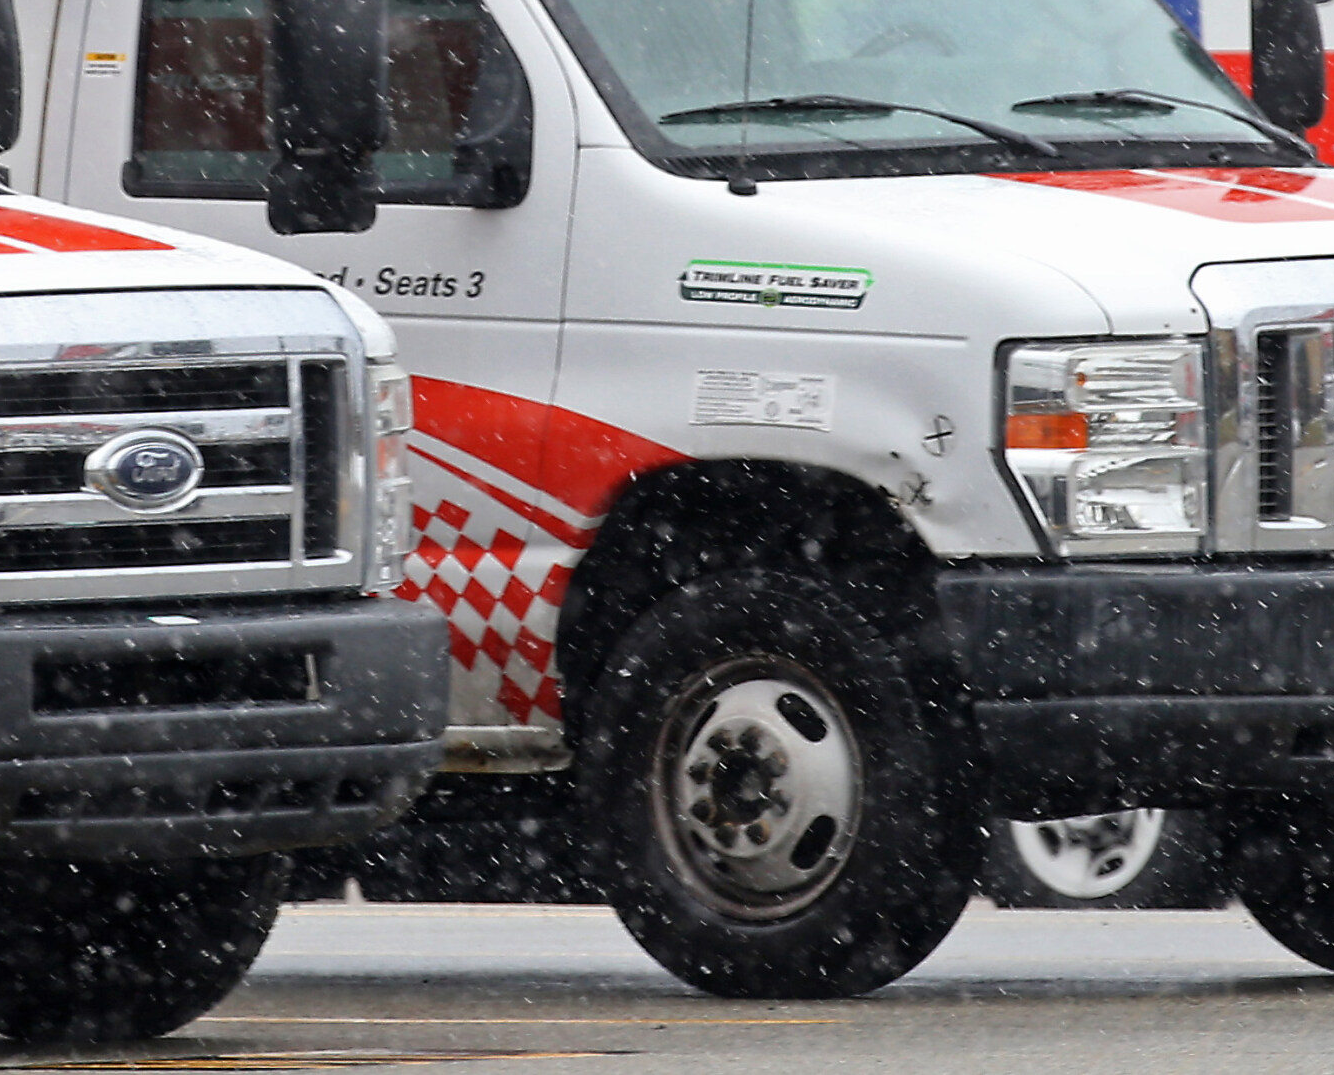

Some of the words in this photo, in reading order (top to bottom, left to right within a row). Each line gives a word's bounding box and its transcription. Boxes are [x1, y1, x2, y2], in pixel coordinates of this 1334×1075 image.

[374, 267, 458, 298] Seats
[466, 271, 486, 299] 3
[768, 274, 806, 288] FUEL
